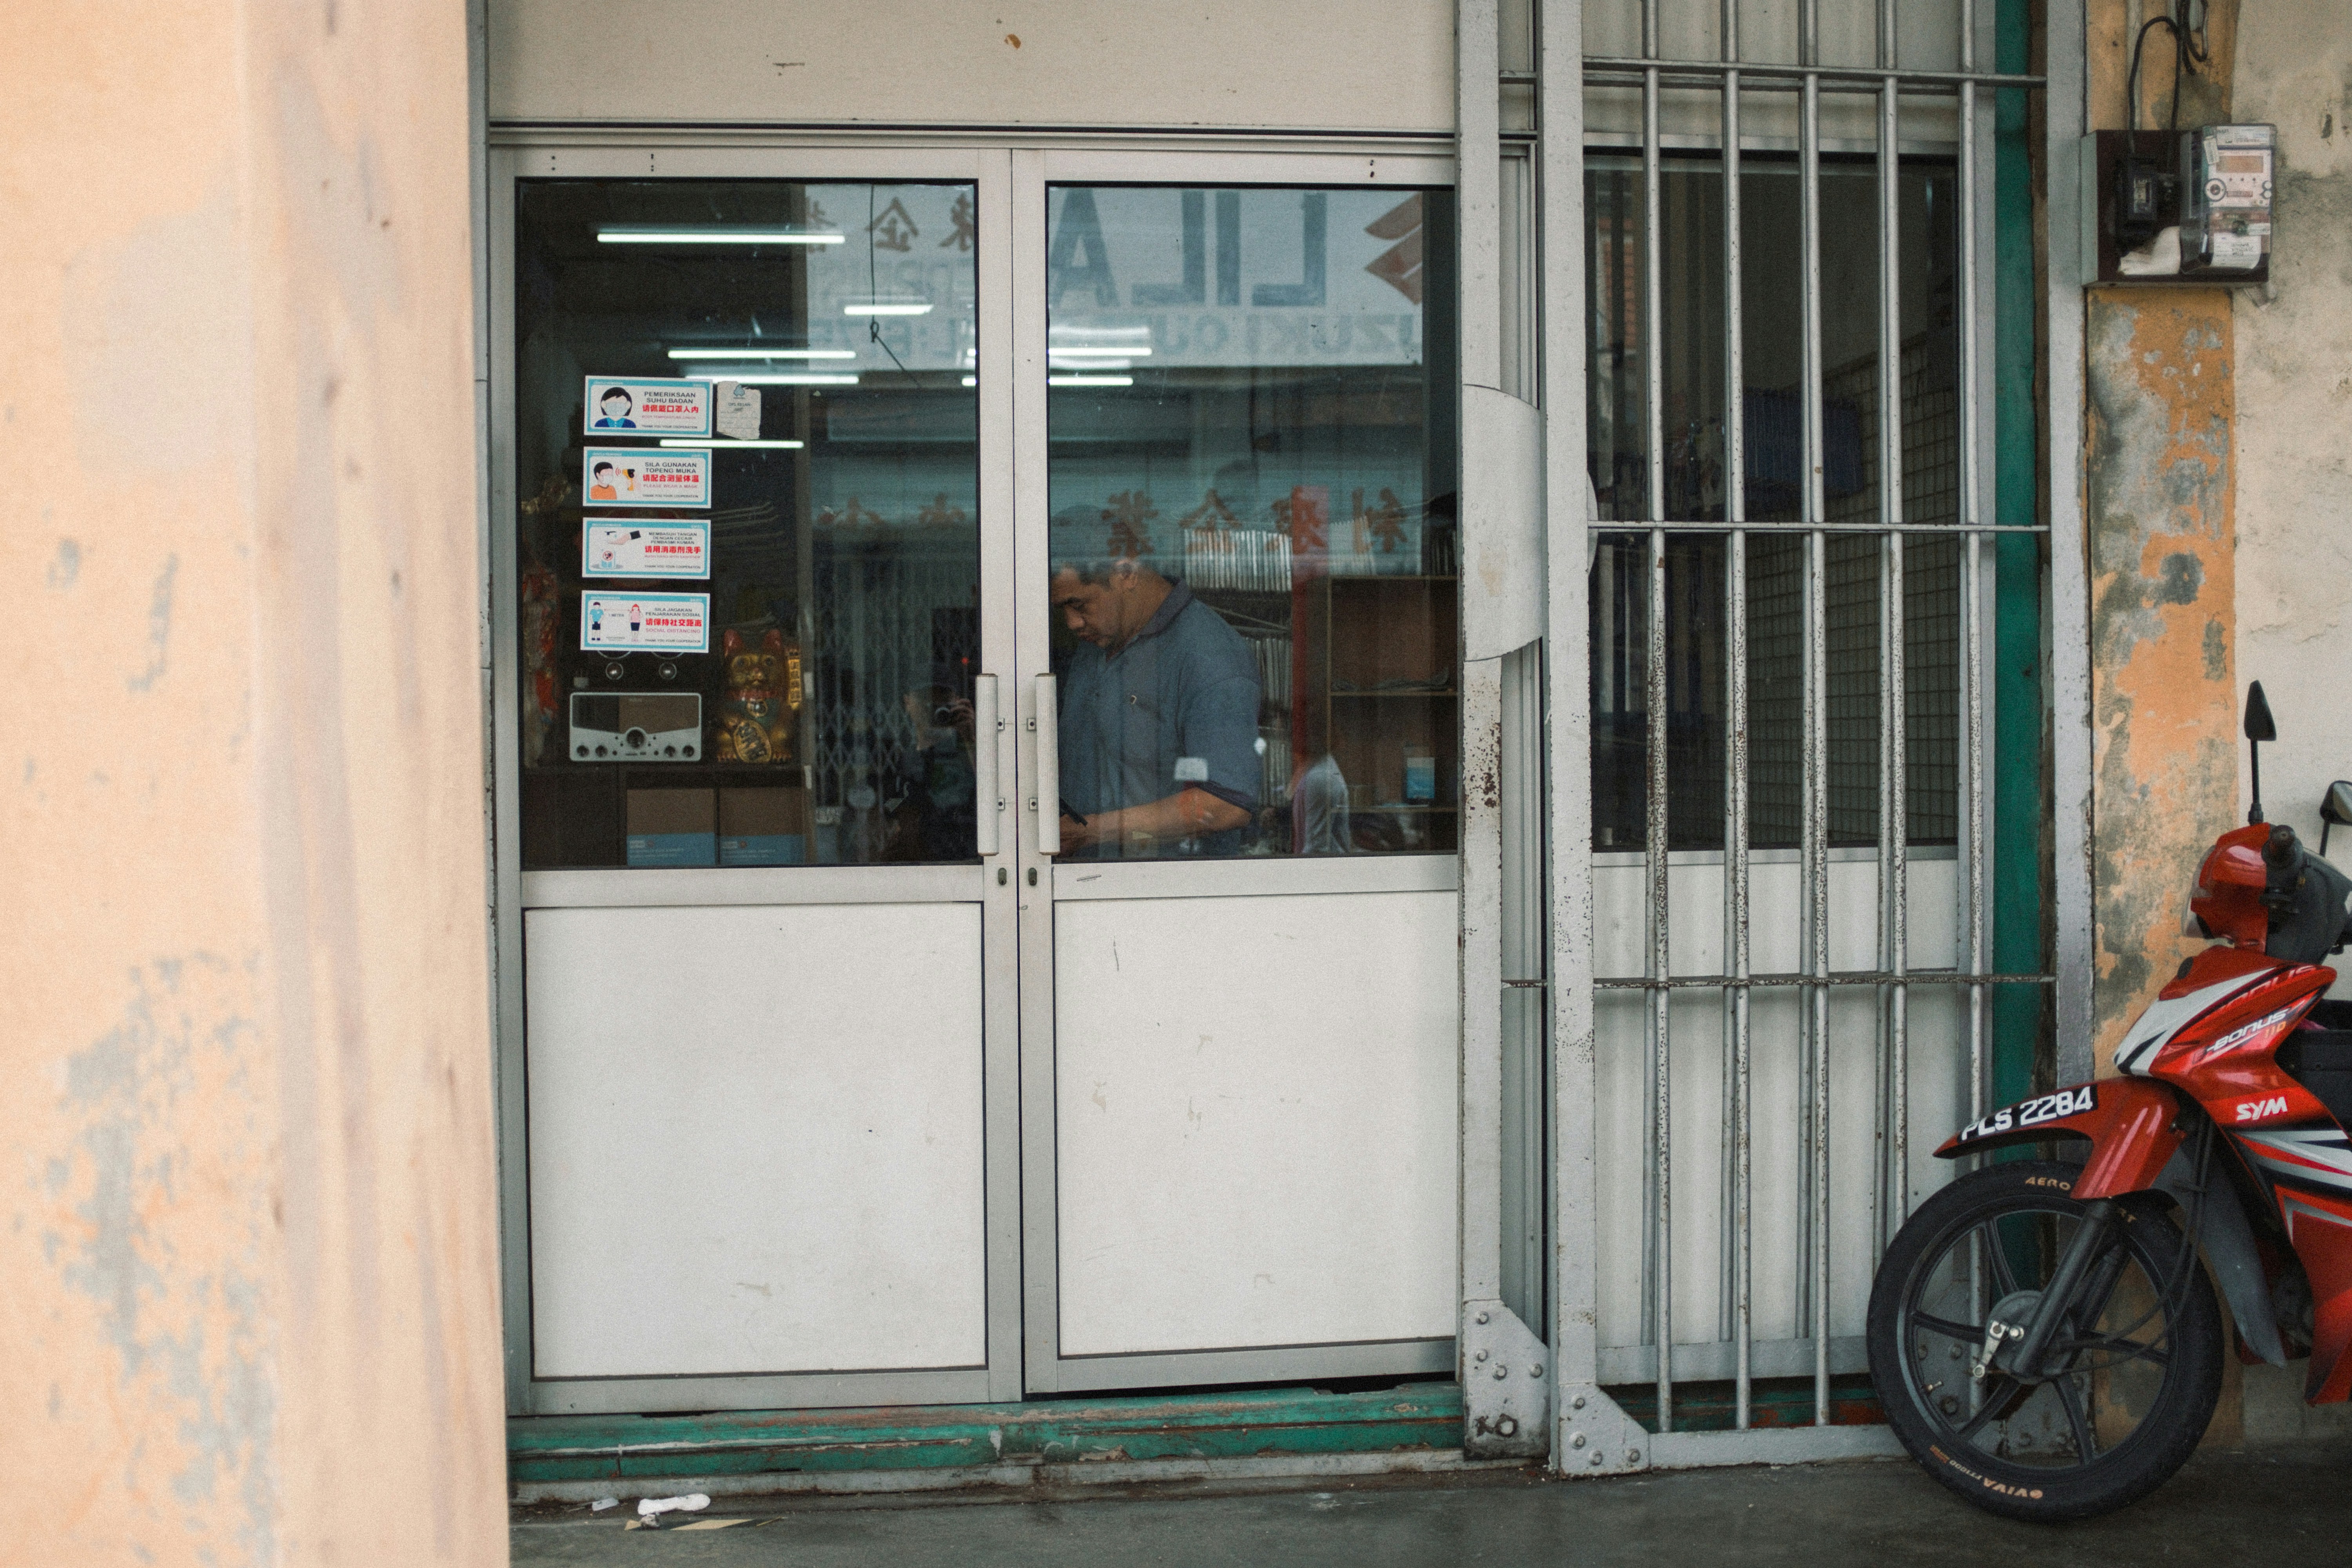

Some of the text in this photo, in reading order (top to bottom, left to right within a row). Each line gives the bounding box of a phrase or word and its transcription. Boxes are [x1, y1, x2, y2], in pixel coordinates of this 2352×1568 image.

[645, 545, 701, 554] 请用消毒剂洗手
[646, 618, 702, 626] 请保持社交距离
[1961, 1086, 2093, 1141] PLS 2284
[2236, 1096, 2288, 1120] SYM
[2025, 1176, 2071, 1191] AERO
[1984, 1477, 2028, 1498] VIVA
